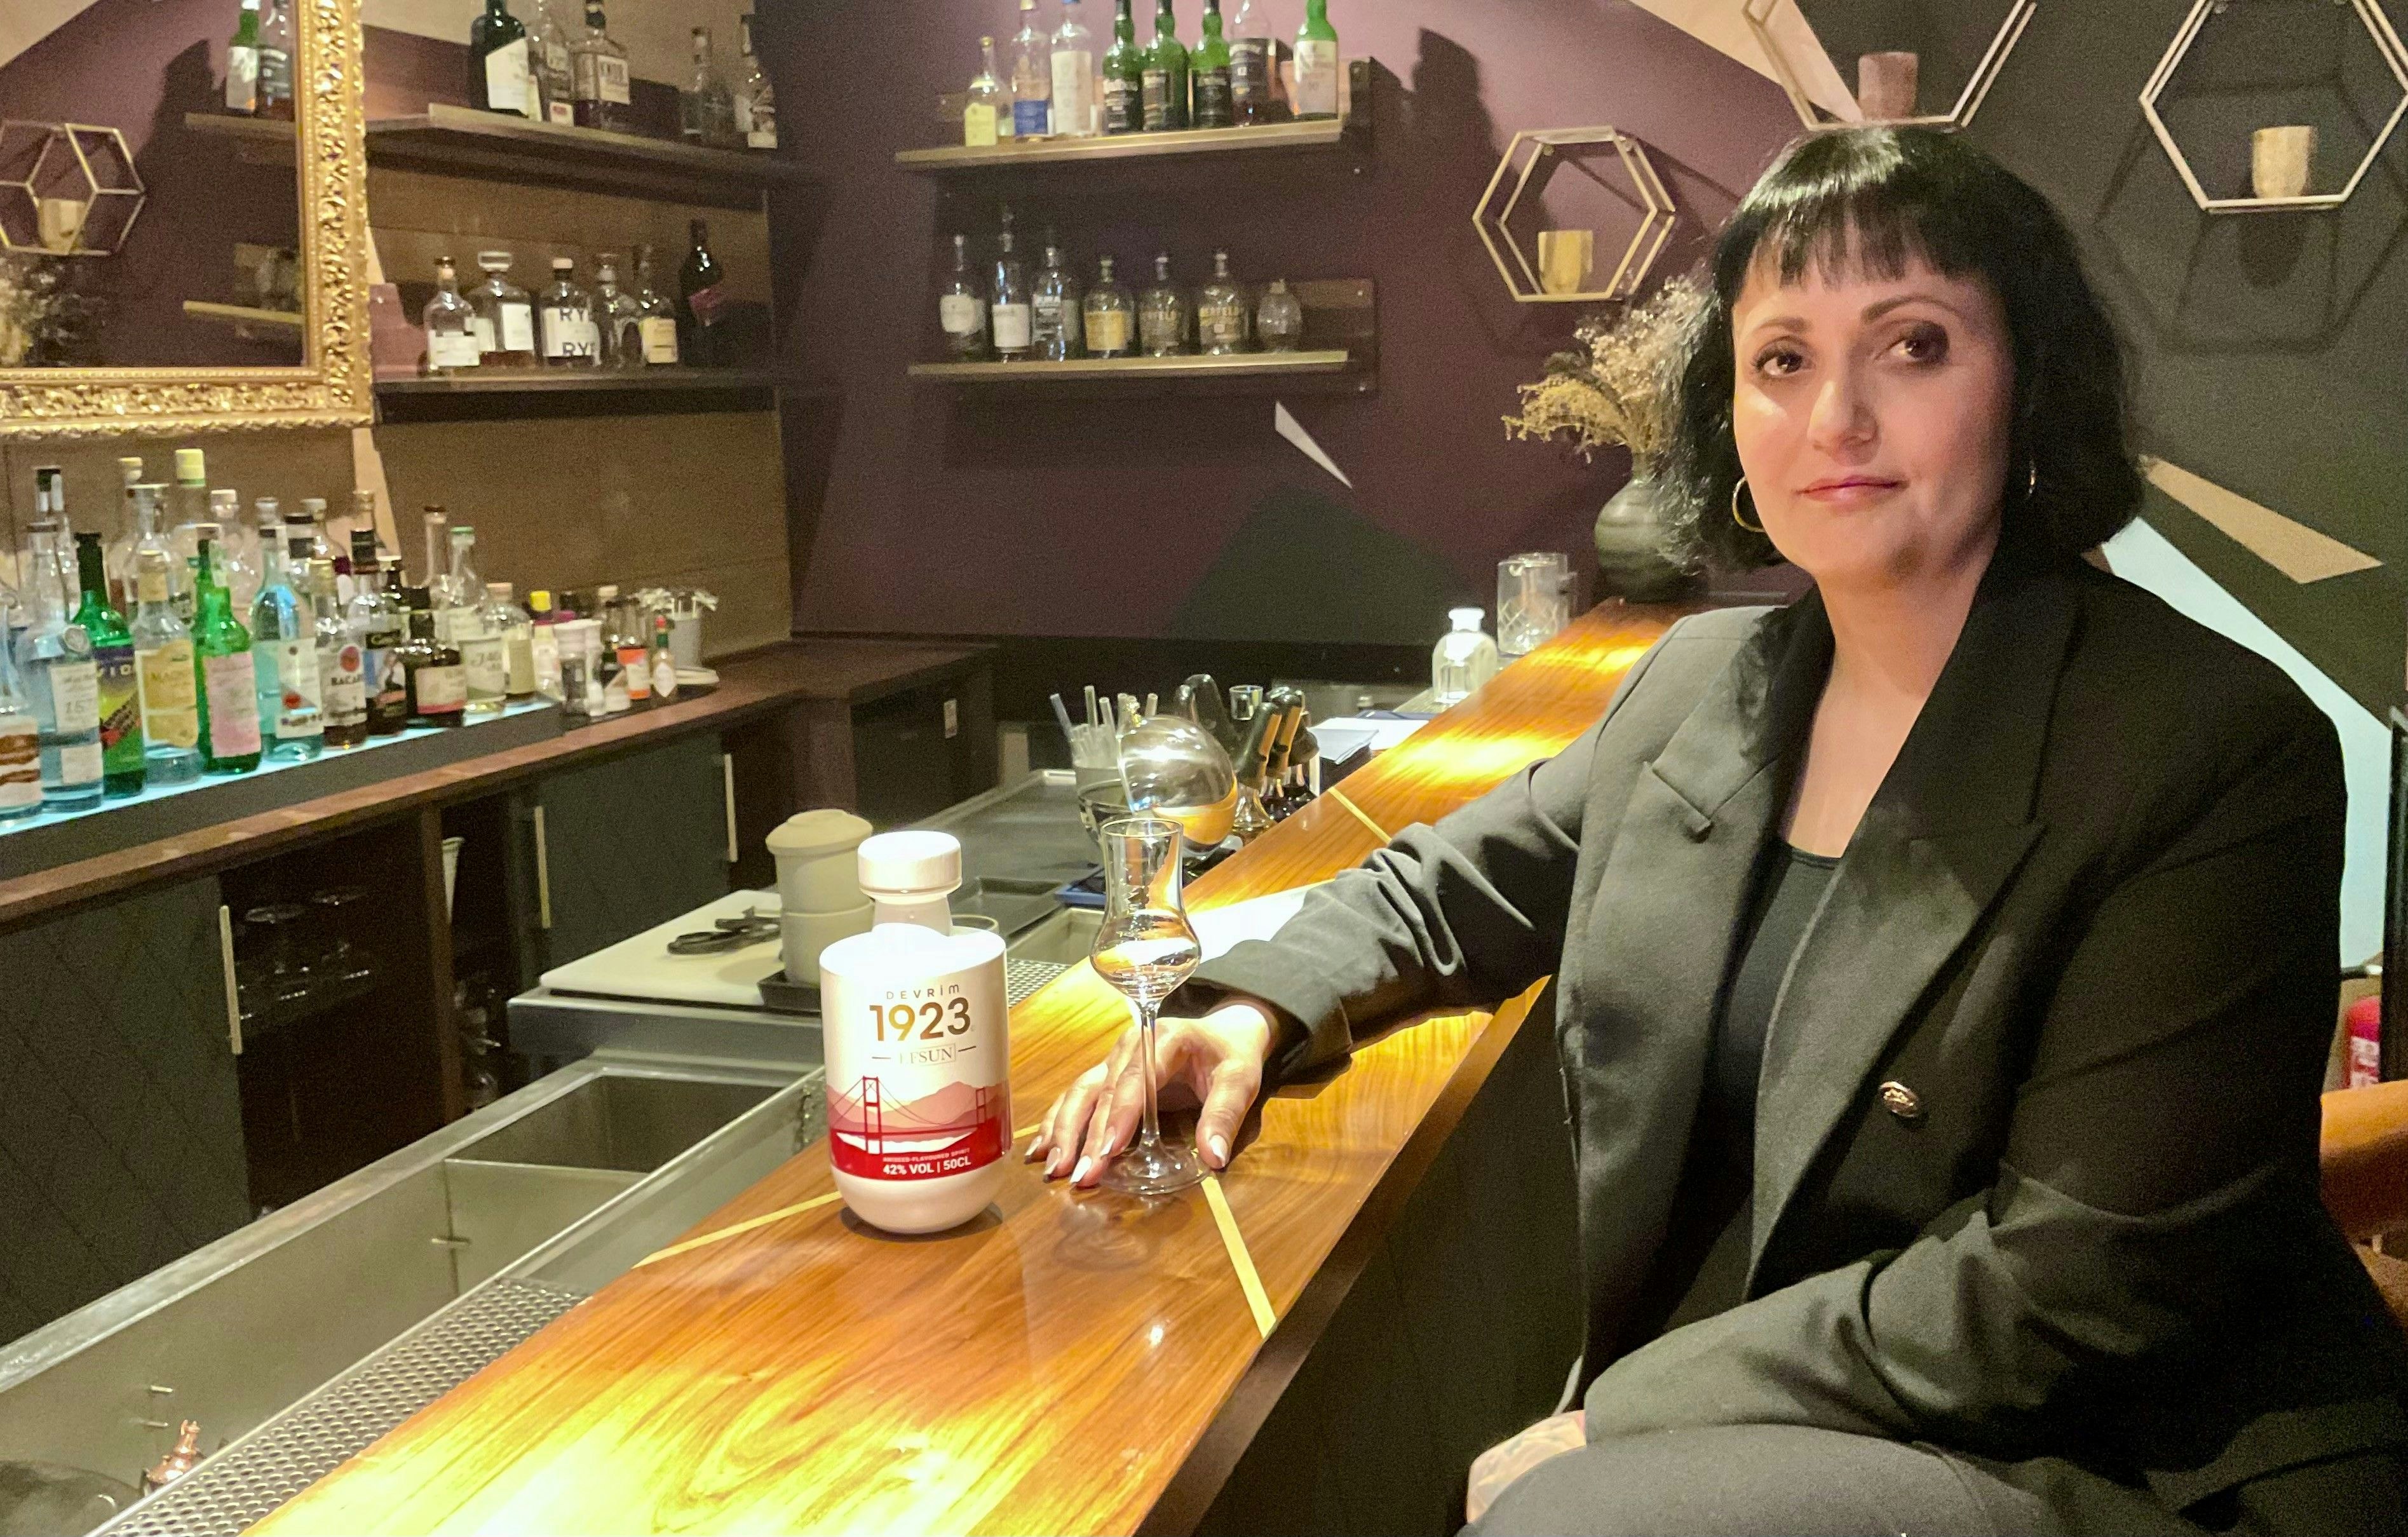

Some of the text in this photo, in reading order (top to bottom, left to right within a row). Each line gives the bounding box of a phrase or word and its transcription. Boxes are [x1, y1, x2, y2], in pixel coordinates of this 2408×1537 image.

[559, 305, 588, 322] RY
[869, 996, 971, 1041] 1923
[899, 1046, 953, 1064] FSUN
[883, 1163, 907, 1175] 42%
[909, 1162, 935, 1174] VOL
[943, 1155, 972, 1170] 50CL
